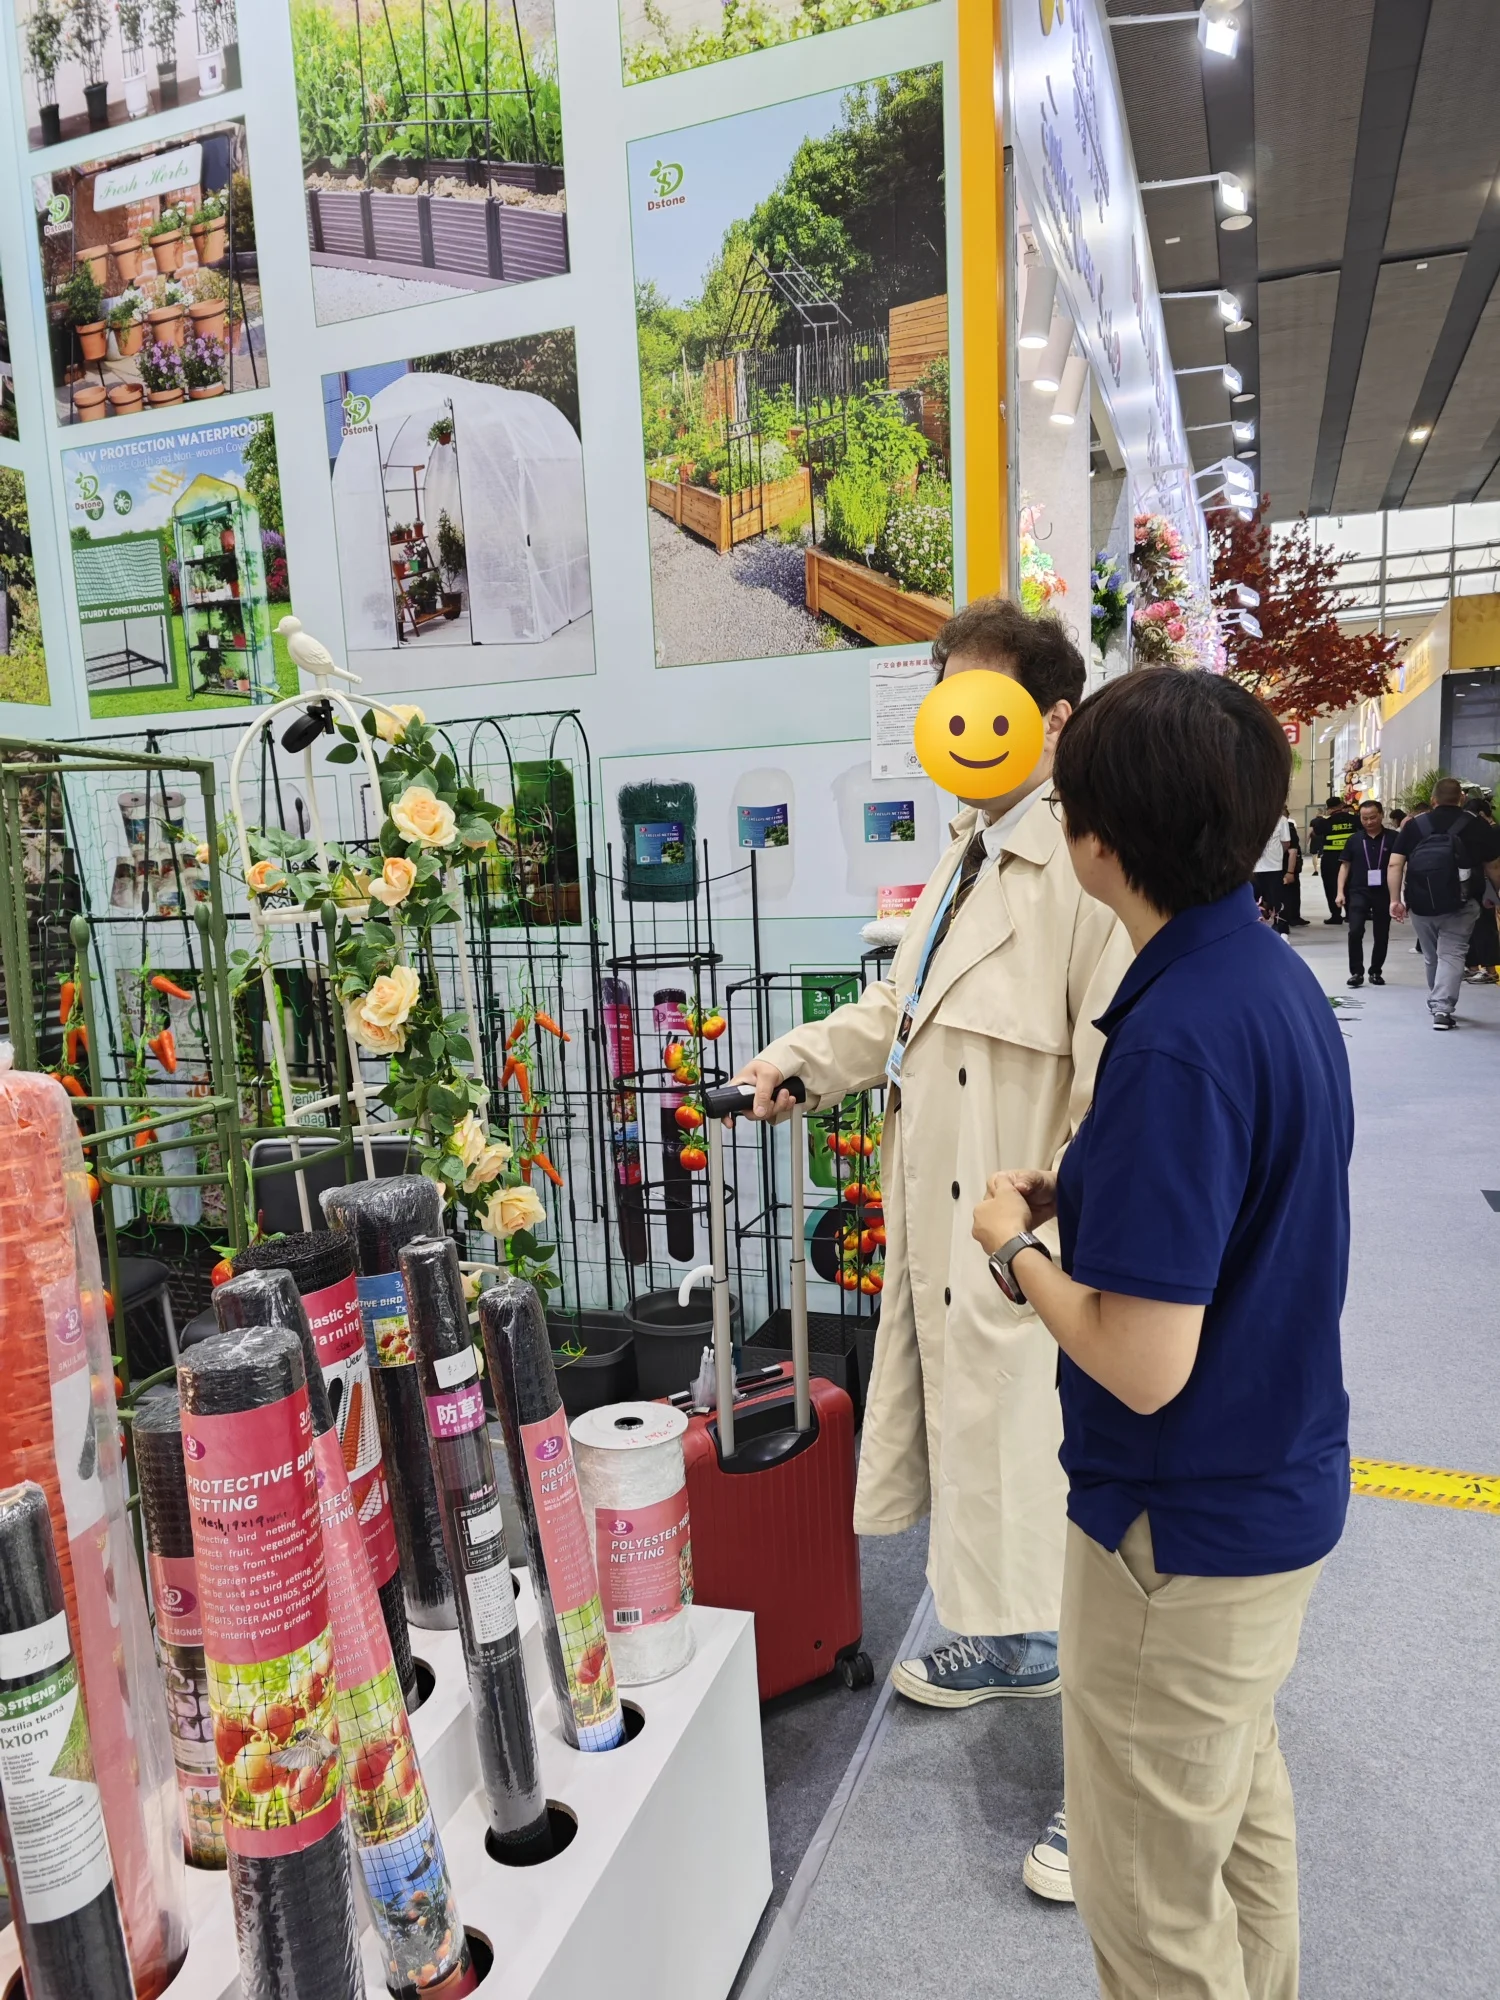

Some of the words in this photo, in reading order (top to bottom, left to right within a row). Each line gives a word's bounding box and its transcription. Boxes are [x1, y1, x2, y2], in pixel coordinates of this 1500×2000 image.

[100, 174, 139, 200] Fresh
[145, 159, 189, 187] Herbs
[647, 196, 686, 211] Dstone
[45, 221, 72, 235] Dstone
[80, 451, 97, 464] UV
[100, 436, 175, 462] PROTECTION
[174, 419, 266, 447] WATERPROOF
[342, 424, 374, 436] Dstone
[97, 463, 117, 474] With
[131, 457, 153, 469] Cloth
[174, 446, 223, 463] Non-woven
[226, 442, 251, 453] Cover
[75, 500, 102, 511] Dstone
[80, 608, 107, 620] STURDY
[109, 602, 164, 616] CONSTRUCTION
[815, 990, 853, 1003] 3-n-1
[359, 1300, 378, 1308] TIVE
[380, 1295, 403, 1307] BIRD
[309, 1309, 344, 1330] lastic
[314, 1317, 360, 1346] arning
[188, 1461, 293, 1494] PROTECTIVE
[189, 1494, 258, 1513] NETTING
[237, 1532, 257, 1543] bird
[266, 1519, 297, 1537] netting
[611, 1526, 677, 1551] POLYESTER
[229, 1548, 253, 1559] fruit,
[260, 1529, 307, 1552] vegetation,
[610, 1546, 665, 1563] NETTING
[210, 1562, 239, 1572] berries
[243, 1559, 267, 1570] from
[270, 1543, 304, 1563] thieving
[213, 1591, 222, 1599] be
[226, 1588, 246, 1598] used
[250, 1588, 260, 1596] as
[263, 1580, 282, 1594] bird
[285, 1567, 313, 1587] netting,
[217, 1576, 247, 1586] garden
[250, 1569, 278, 1584] pests.
[229, 1603, 251, 1613] Keep
[254, 1600, 270, 1610] out
[274, 1588, 300, 1605] BIRDS,
[236, 1615, 259, 1626] DEER
[262, 1608, 283, 1622] AND
[285, 1594, 311, 1614] OTHER
[221, 1629, 257, 1641] entering
[259, 1623, 281, 1638] your
[284, 1610, 313, 1630] garden.
[334, 1644, 349, 1654] ELS,
[7, 1684, 57, 1711] STREND
[0, 1718, 33, 1735] extília
[36, 1703, 65, 1725] tkaná
[0, 1728, 49, 1750] 1x10m
